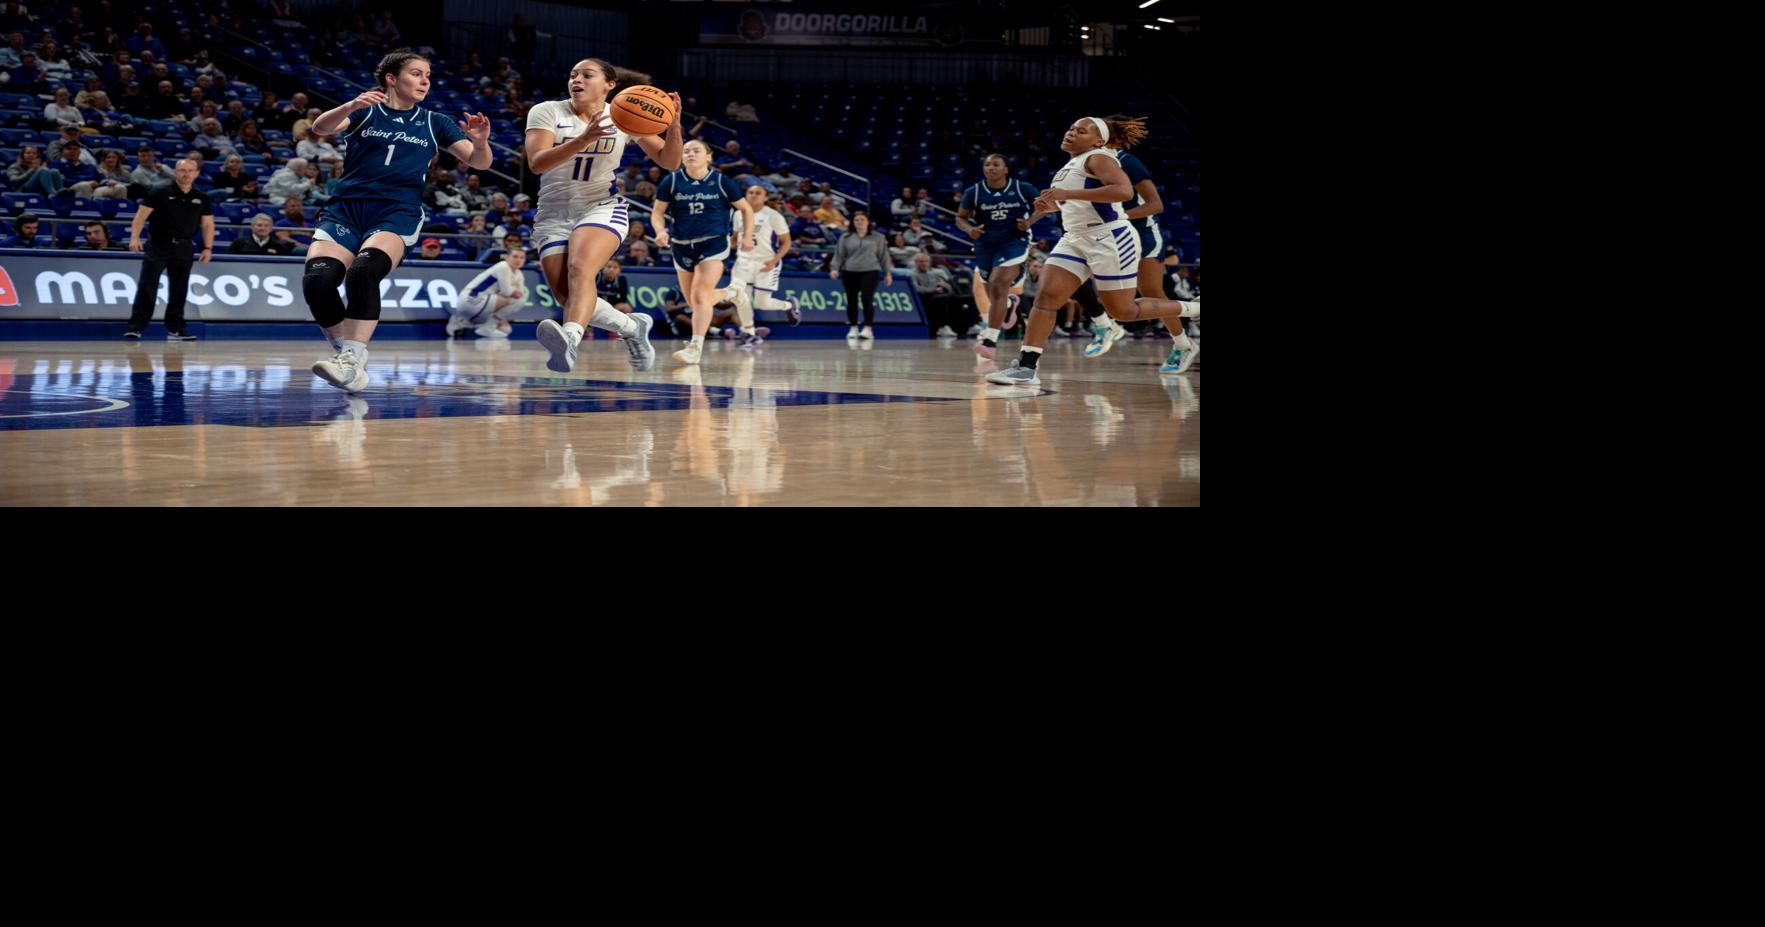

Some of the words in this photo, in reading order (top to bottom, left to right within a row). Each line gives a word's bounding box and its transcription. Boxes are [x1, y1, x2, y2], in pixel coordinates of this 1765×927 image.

[775, 14, 927, 32] DOORGORILLA
[626, 96, 665, 118] Wilson
[361, 126, 392, 139] Saint
[393, 131, 428, 148] Peter's
[384, 144, 395, 166] 1
[572, 157, 593, 181] 11
[688, 202, 704, 215] 12
[991, 210, 1008, 220] 25
[337, 278, 459, 308] ZZA
